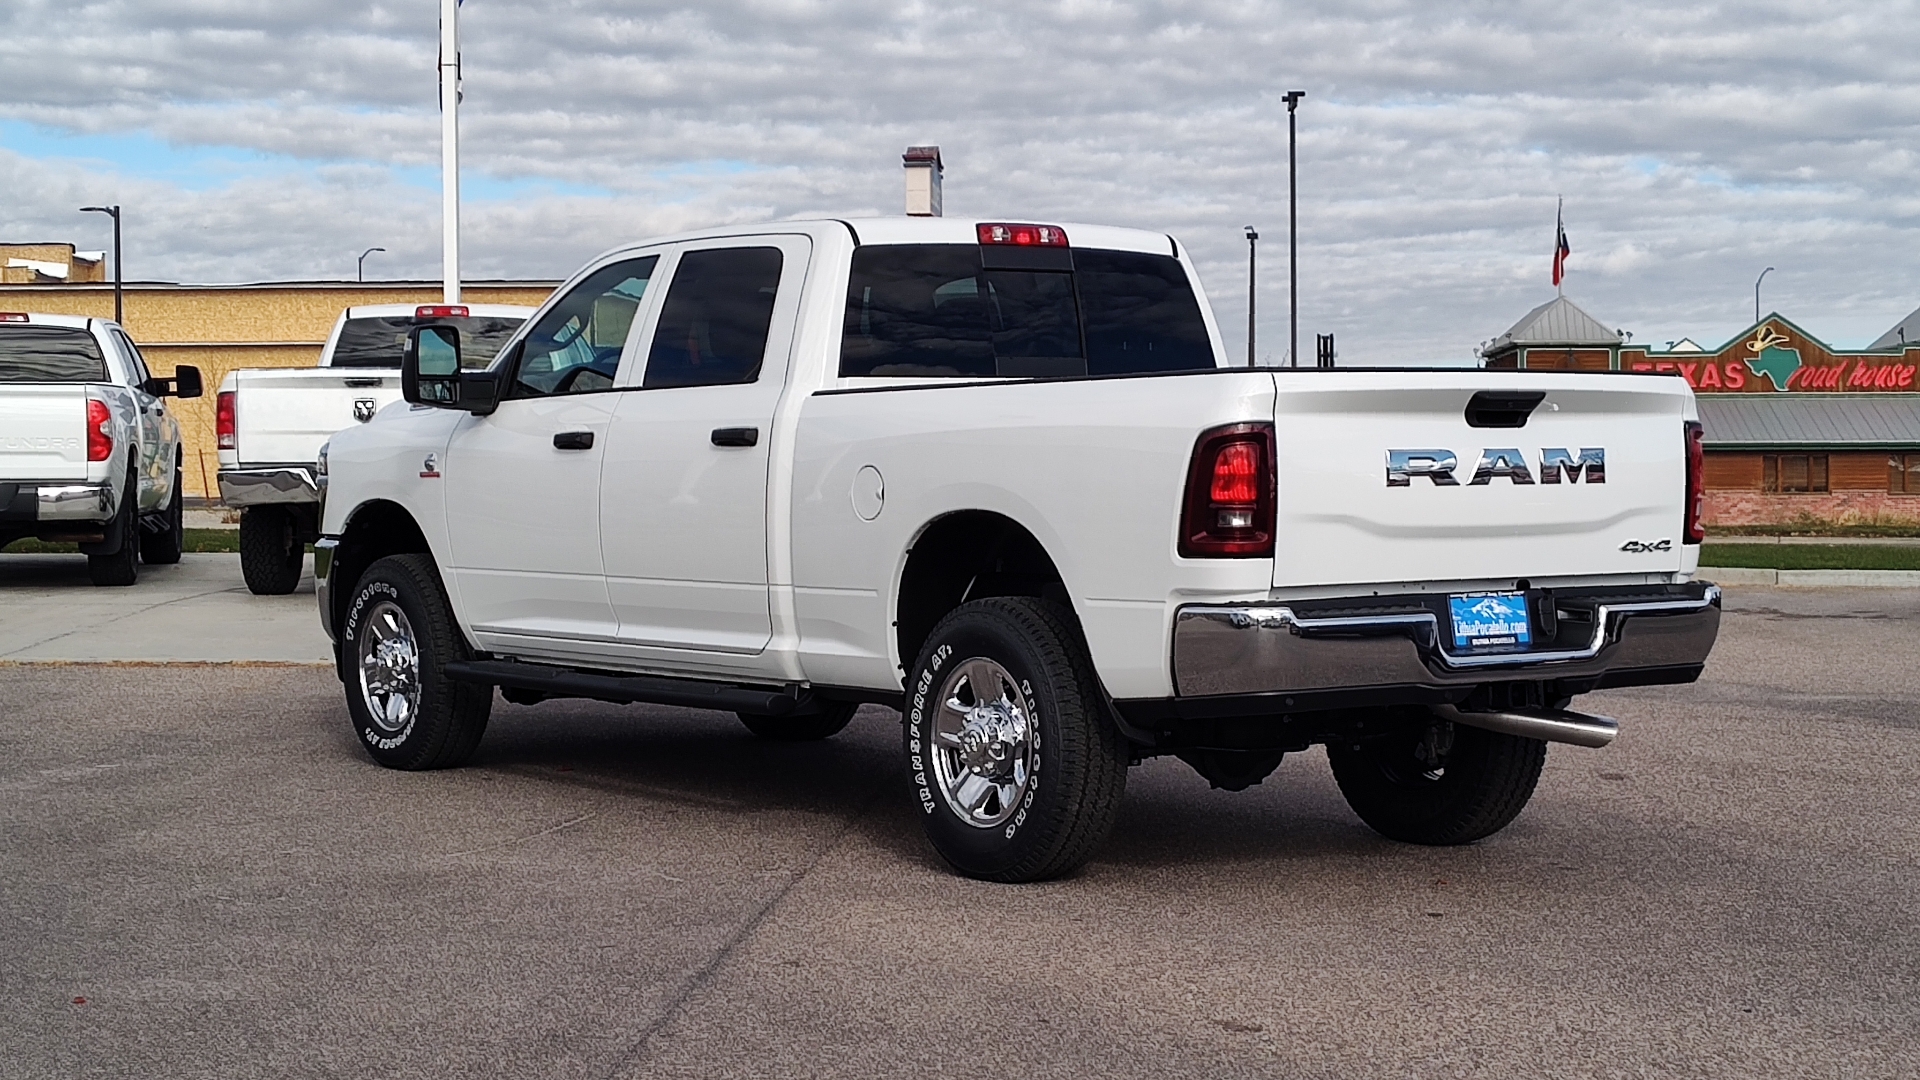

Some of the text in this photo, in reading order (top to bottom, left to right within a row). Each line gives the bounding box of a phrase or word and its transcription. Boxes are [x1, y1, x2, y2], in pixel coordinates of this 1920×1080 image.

[1845, 359, 1916, 389] house
[1385, 448, 1606, 487] RAM
[910, 668, 936, 814] TRANSFORCE
